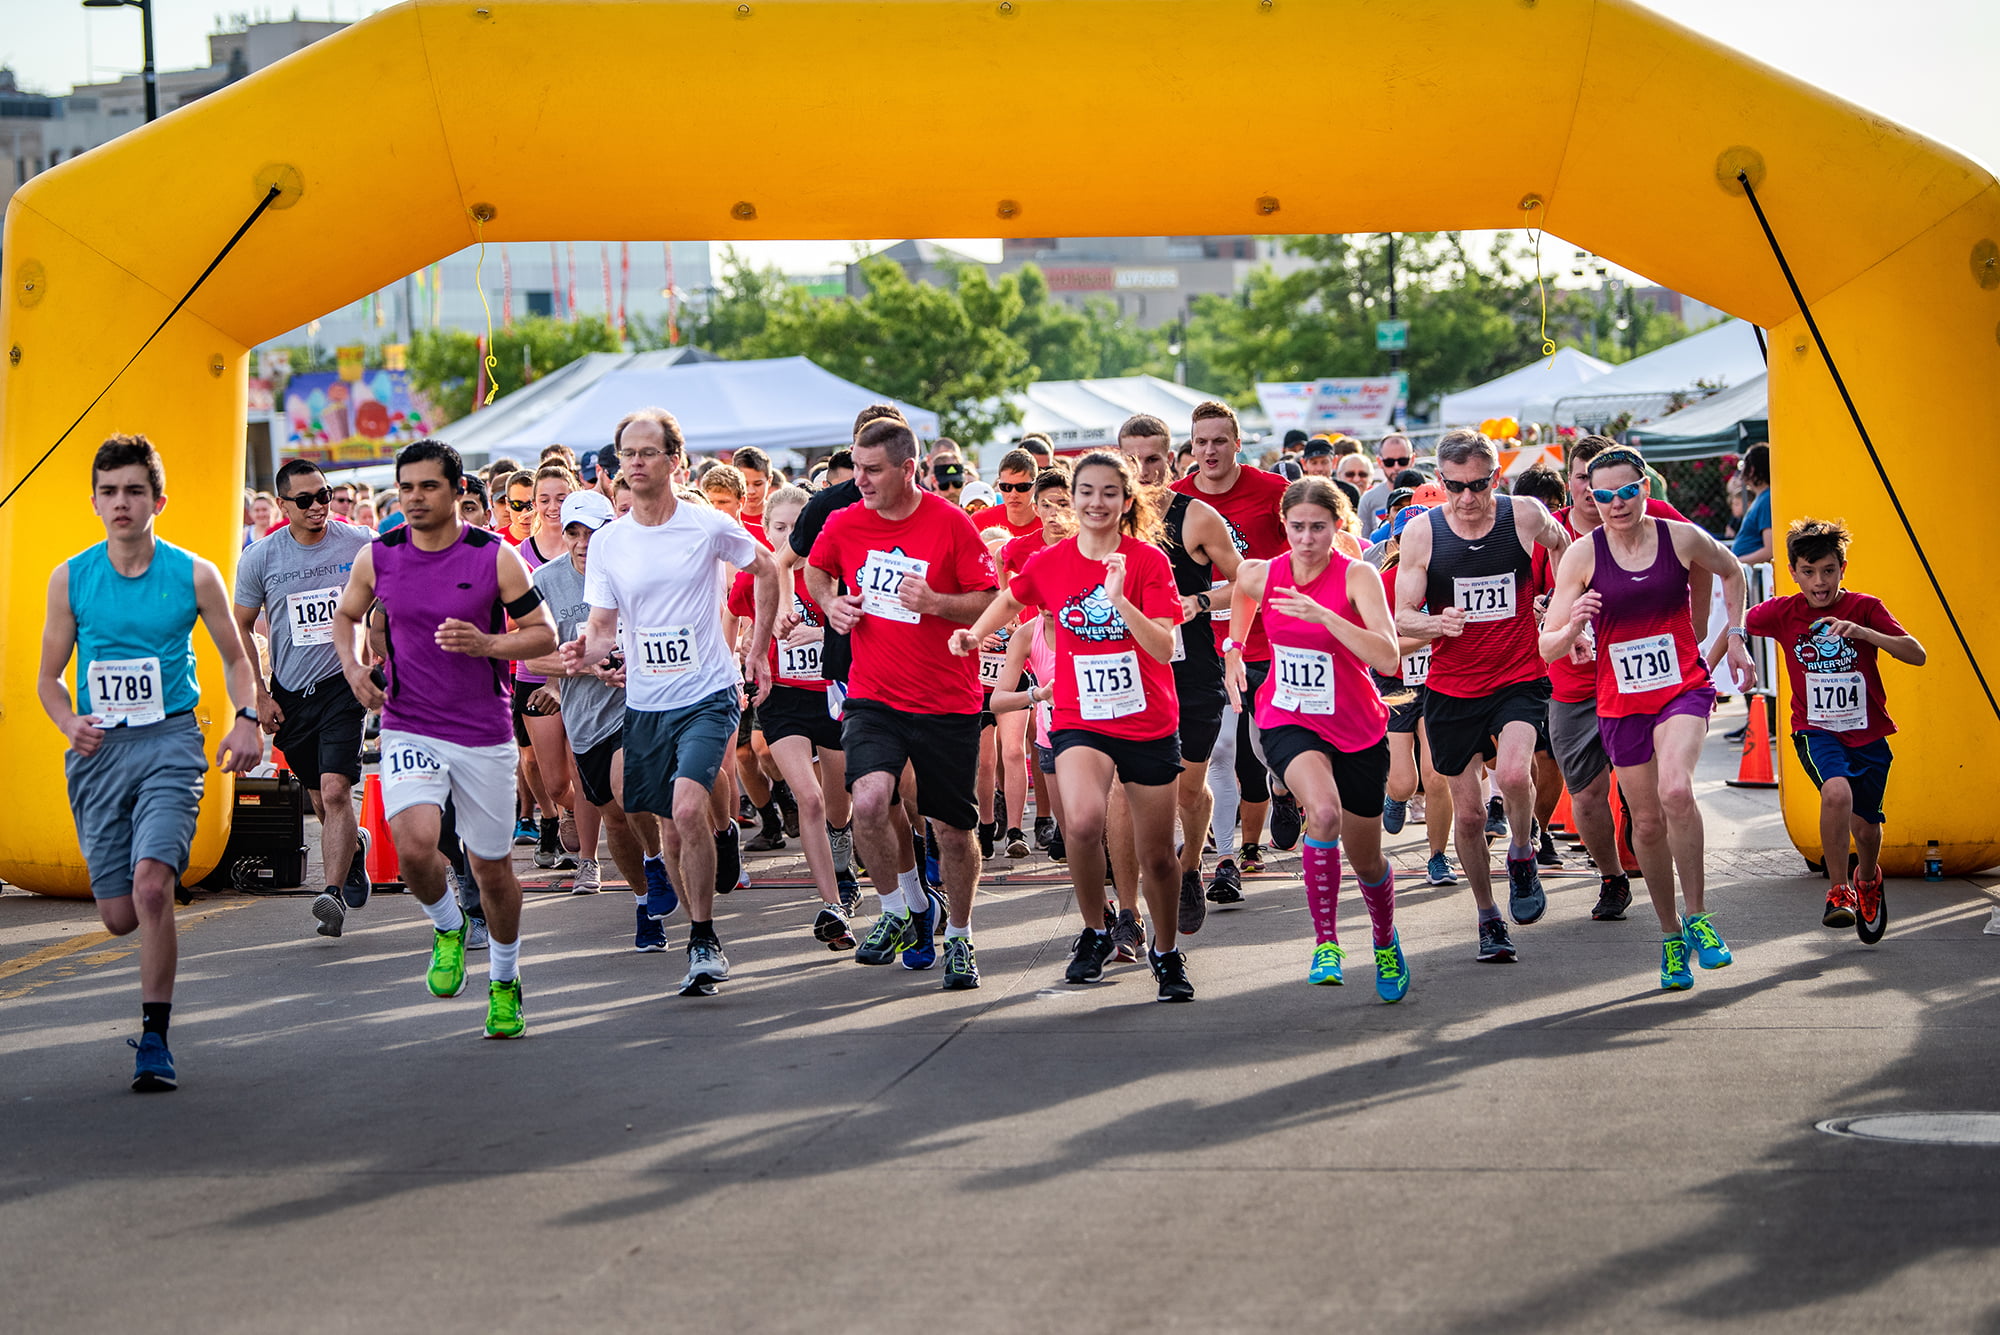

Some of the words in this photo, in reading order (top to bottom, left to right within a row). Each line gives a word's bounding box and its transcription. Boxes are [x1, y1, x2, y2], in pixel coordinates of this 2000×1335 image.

[272, 564, 338, 585] SUPPLEMENT
[560, 603, 591, 619] SUPP
[1462, 587, 1508, 611] 1731
[295, 599, 337, 625] 1820
[643, 639, 691, 664] 1162
[786, 647, 823, 671] 139
[982, 661, 1005, 679] 51
[1281, 659, 1326, 687] 1112
[1619, 649, 1671, 681] 1730
[97, 675, 152, 701] 1789
[1084, 666, 1133, 693] 1753
[1813, 685, 1859, 709] 1704
